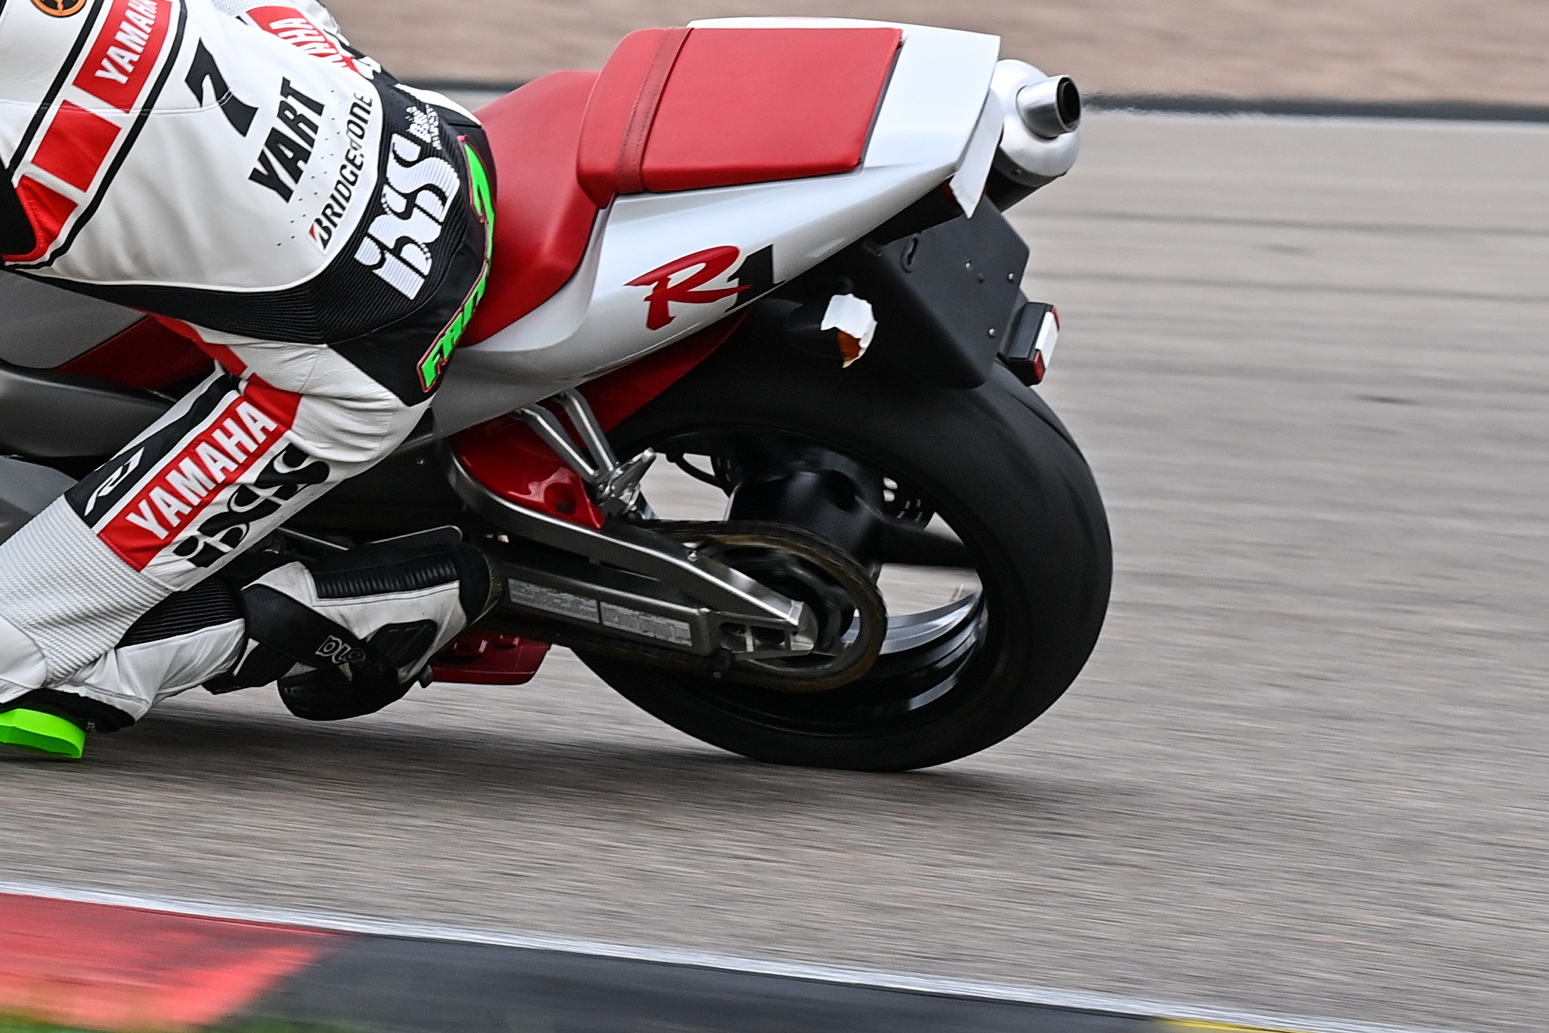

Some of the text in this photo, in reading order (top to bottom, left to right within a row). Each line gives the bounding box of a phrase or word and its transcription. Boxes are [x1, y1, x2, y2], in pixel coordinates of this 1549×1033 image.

[184, 36, 259, 138] 7
[247, 76, 325, 203] YART
[623, 243, 786, 332] R1
[125, 401, 279, 541] YAMAHA
